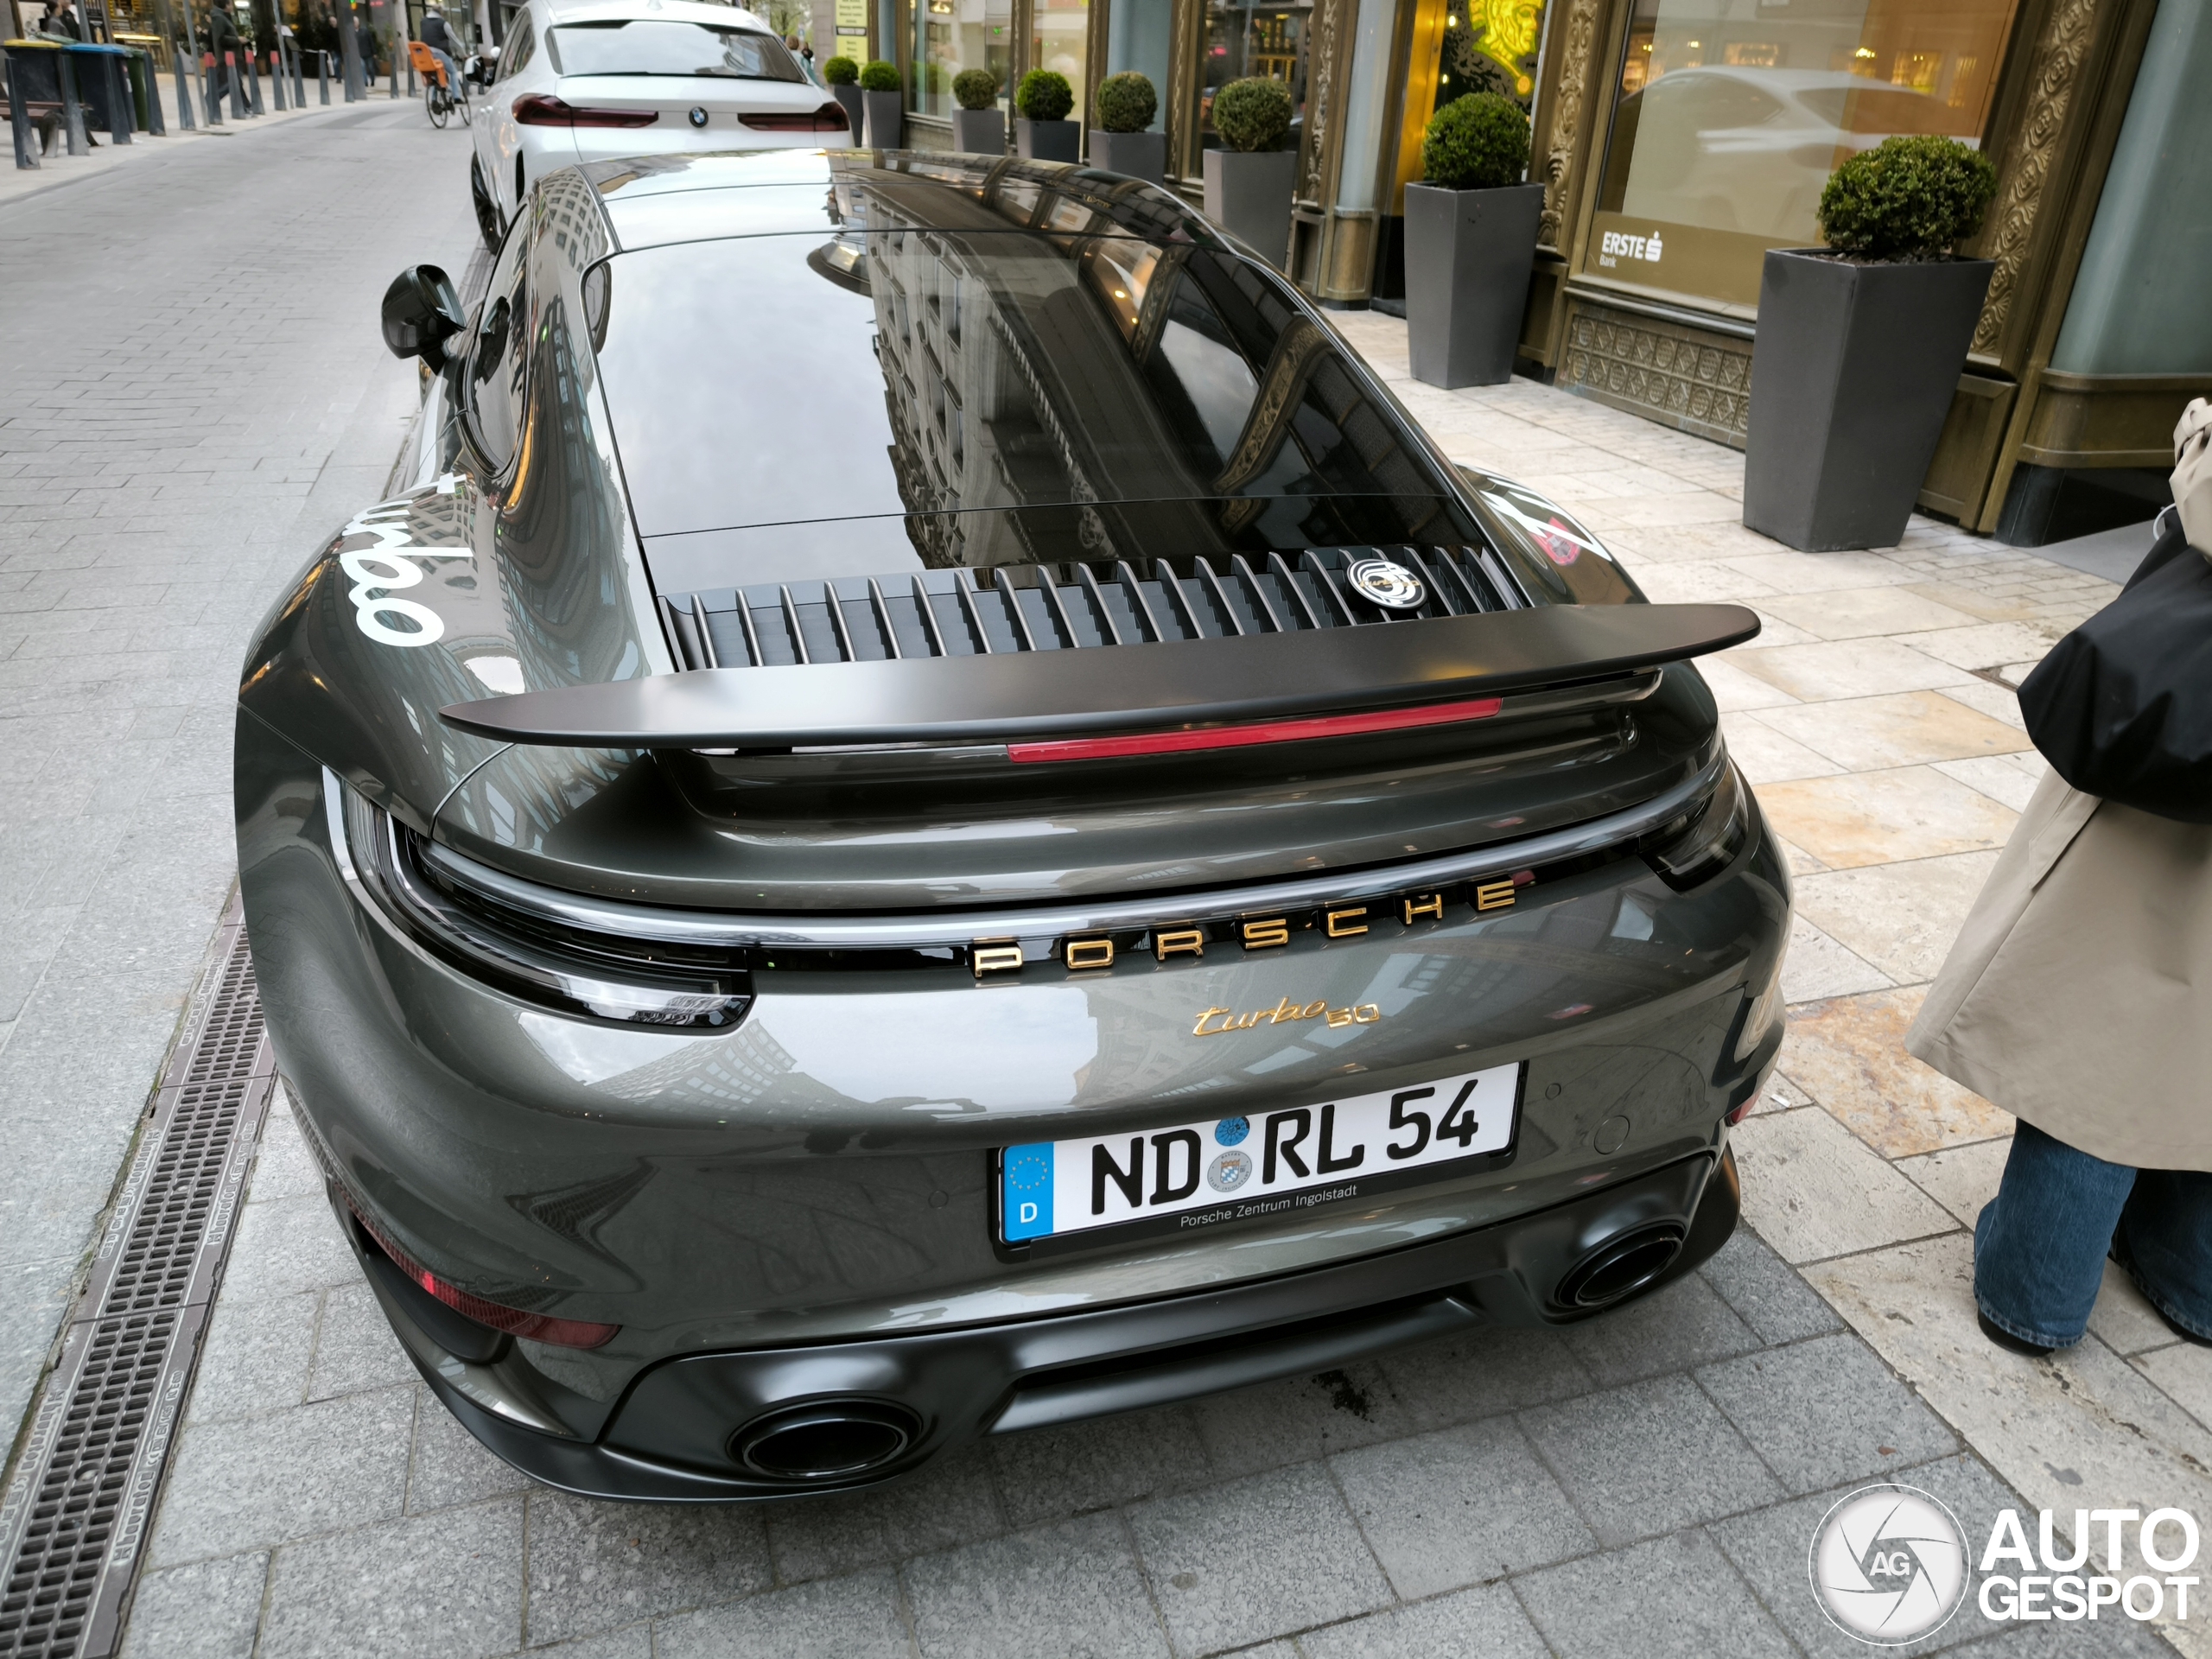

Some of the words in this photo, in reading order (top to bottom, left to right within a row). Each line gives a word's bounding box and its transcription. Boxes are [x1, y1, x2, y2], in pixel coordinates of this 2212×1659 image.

[1599, 253, 1617, 268] Bank
[1602, 231, 1646, 259] ERSTE
[974, 880, 1516, 978] PORSCHE
[1192, 995, 1327, 1036] turbo
[1325, 1003, 1380, 1029] 50
[1091, 1128, 1202, 1216] ND
[1262, 1103, 1365, 1185] RL
[1386, 1078, 1479, 1160] 54
[1020, 1202, 1038, 1224] D
[1180, 1210, 1232, 1228] Porsche
[1236, 1199, 1291, 1217] Zentrum
[1295, 1185, 1357, 1207] Ingolstadt
